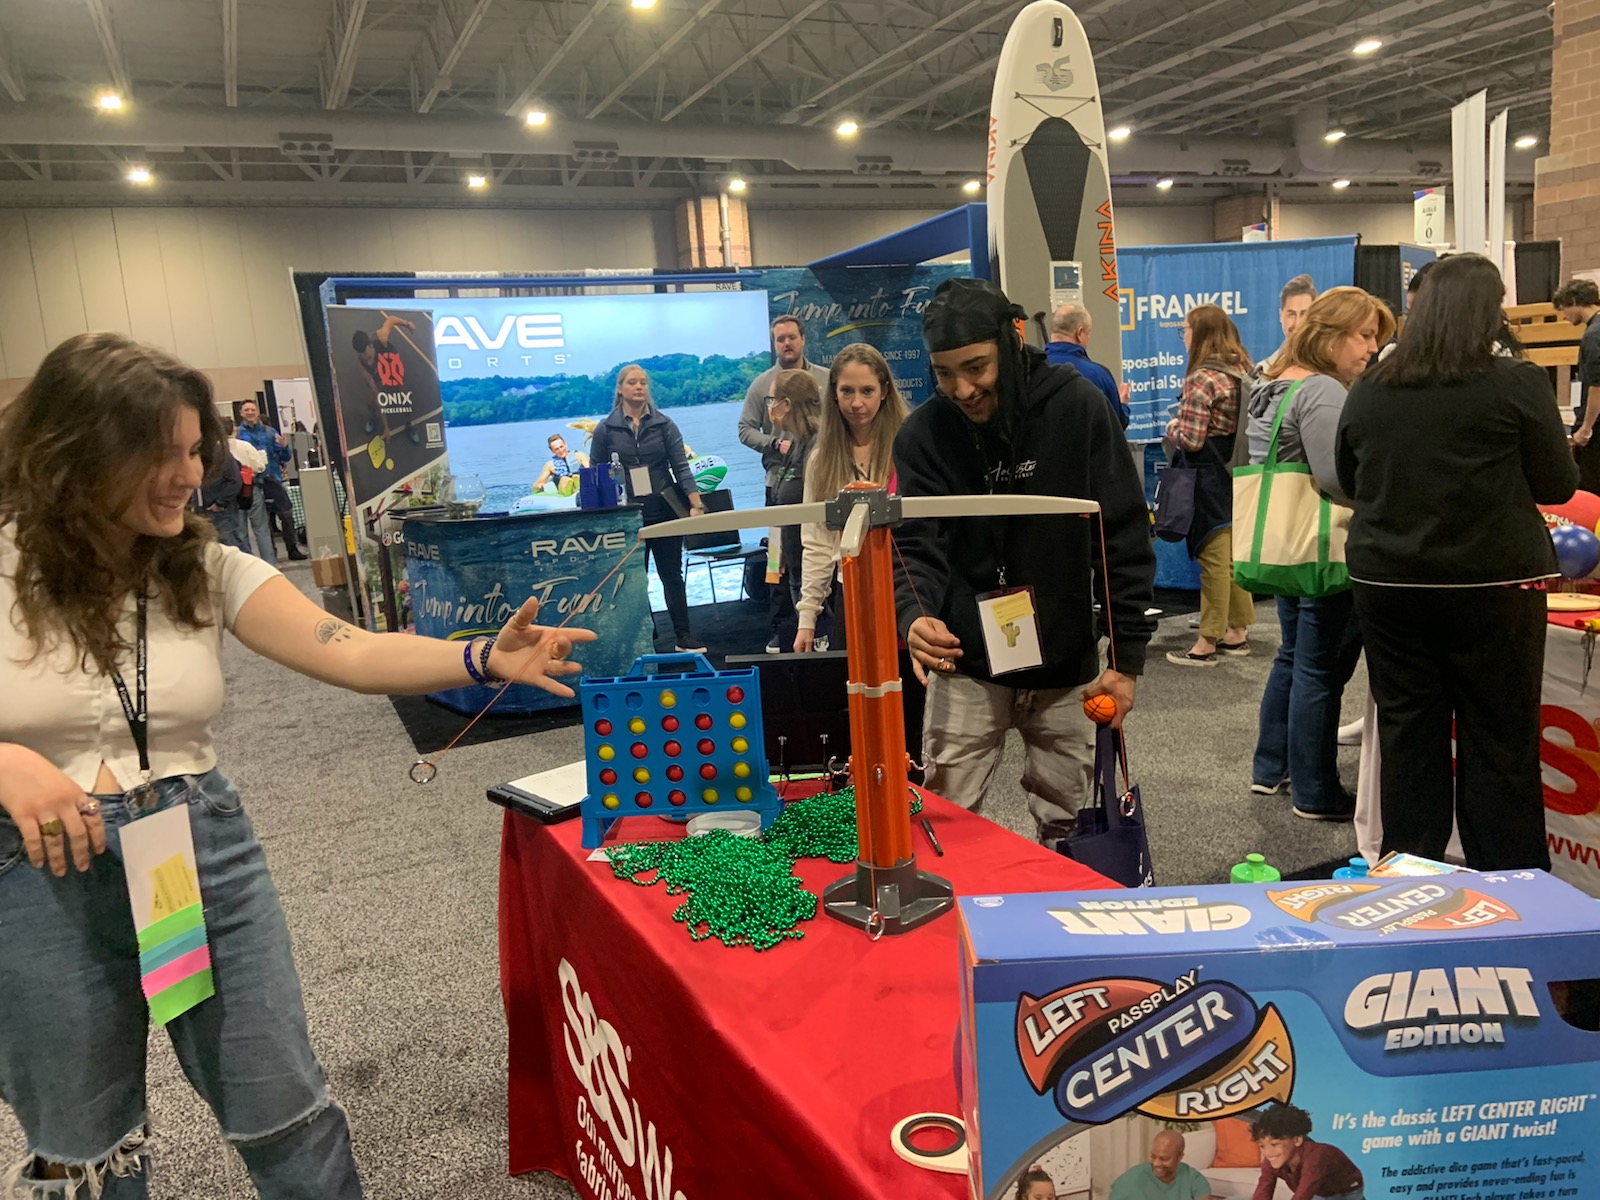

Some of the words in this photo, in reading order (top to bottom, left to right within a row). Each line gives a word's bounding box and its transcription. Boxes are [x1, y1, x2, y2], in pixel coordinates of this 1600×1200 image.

[1421, 205, 1437, 214] AISLE
[1096, 200, 1119, 303] AKINA
[773, 290, 842, 325] Jump
[847, 287, 893, 319] into
[901, 285, 932, 319] Fu
[434, 314, 565, 350] AVE
[448, 353, 567, 369] ORTS
[884, 351, 902, 360] SINCE
[904, 349, 920, 359] 1997
[1122, 351, 1184, 373] sposables
[377, 391, 413, 407] ONIX
[380, 406, 413, 414] PICKLEBALL
[407, 540, 440, 561] RAVE
[530, 531, 627, 558] RAVE
[414, 579, 452, 625] Jump
[456, 582, 519, 625] into
[531, 572, 625, 617] Fun!
[1077, 896, 1200, 912] EDITION
[1276, 884, 1356, 911] RIGHT
[1337, 884, 1447, 928] CENTER
[1046, 904, 1252, 935] GIANT
[1381, 908, 1438, 935] PASSPLAY
[1444, 899, 1507, 927] LEFT
[1107, 969, 1200, 1034] PASSPLAY
[1344, 966, 1541, 1029] GIANT
[1024, 986, 1110, 1056] LEFT
[1065, 990, 1234, 1109] CENTER
[1384, 1021, 1506, 1051] EDITION
[1177, 1041, 1290, 1115] RIGHT
[1331, 1113, 1357, 1130] It's
[1361, 1110, 1386, 1128] the
[1390, 1108, 1437, 1127] classic
[1441, 1104, 1475, 1123] LEFT
[1478, 1100, 1535, 1120] CENTER
[1361, 1135, 1403, 1154] game
[1407, 1128, 1442, 1146] with
[1445, 1130, 1456, 1144] a
[1459, 1123, 1510, 1143] GIANT
[1512, 1119, 1558, 1139] twist!
[1381, 1166, 1399, 1178] The
[1401, 1161, 1446, 1176] addictive
[1449, 1160, 1468, 1173] dice
[1471, 1163, 1498, 1174] game
[1500, 1157, 1529, 1170] that's
[1389, 1181, 1414, 1195] easy
[1416, 1179, 1435, 1192] and
[1436, 1175, 1479, 1191] provides
[1482, 1170, 1547, 1187] never-ending
[1549, 1169, 1566, 1182] fun
[1568, 1169, 1576, 1180] is
[1520, 1190, 1545, 1200] takes
[1558, 1187, 1579, 1197] turn
